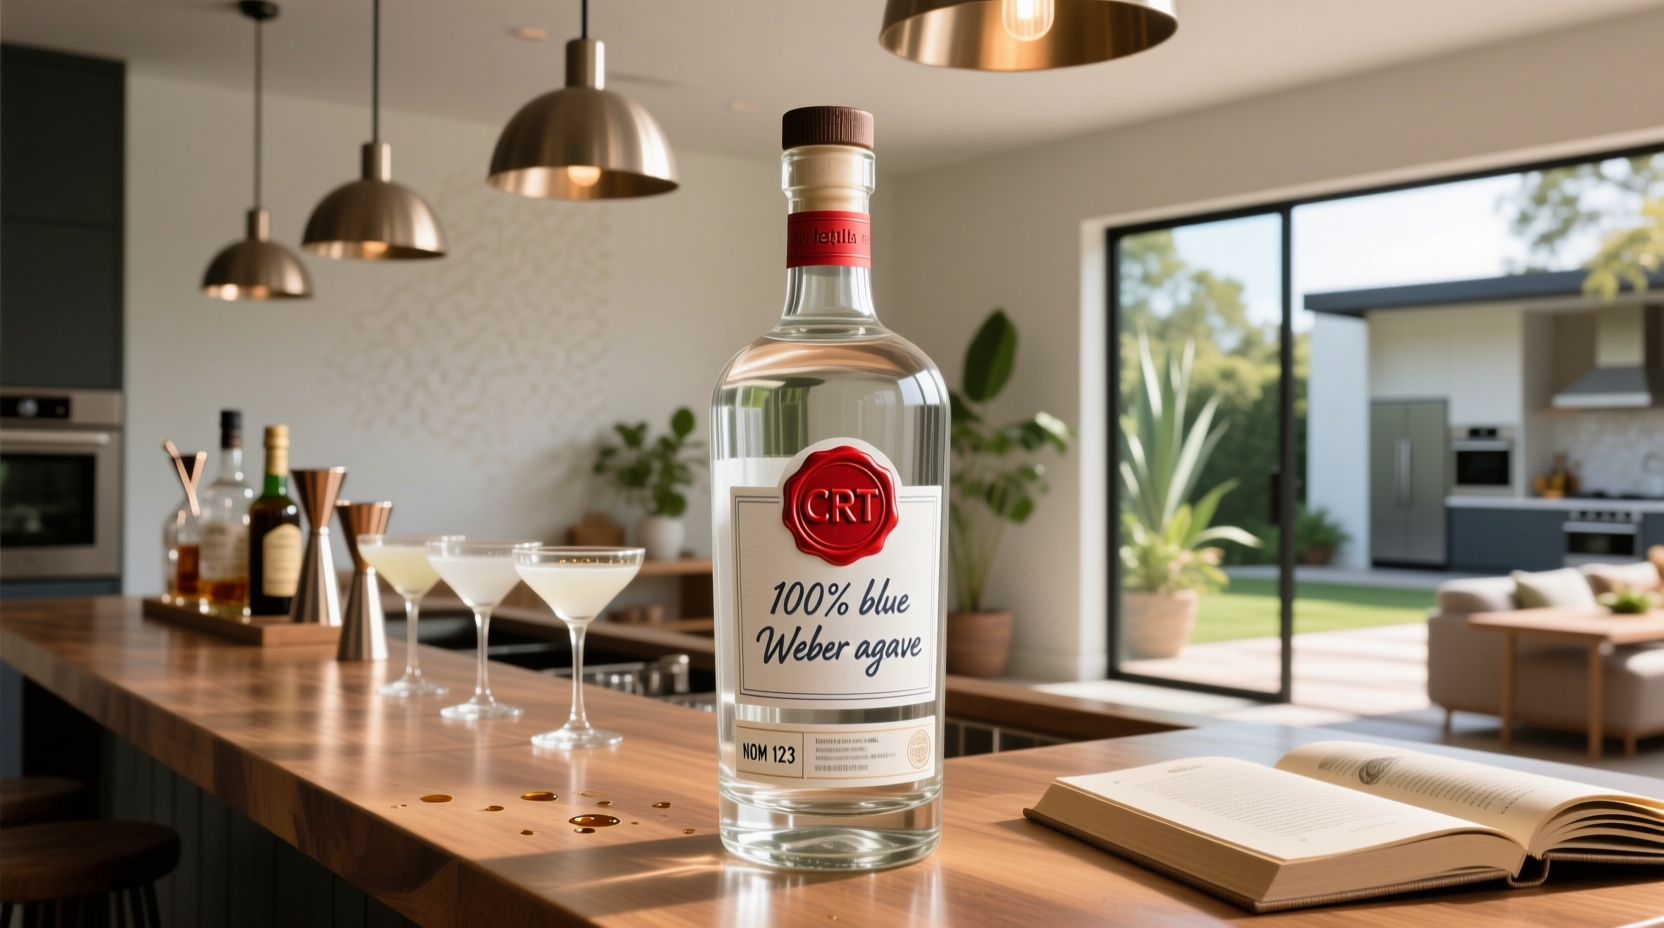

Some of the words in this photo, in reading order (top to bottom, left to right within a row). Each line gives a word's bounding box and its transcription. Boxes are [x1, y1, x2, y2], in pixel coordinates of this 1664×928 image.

[804, 488, 879, 523] CRT
[770, 581, 851, 617] 100%
[858, 578, 911, 616] blue
[756, 624, 851, 664] Weber
[854, 636, 922, 677] agave
[743, 742, 768, 762] NOM
[772, 745, 796, 764] 123
